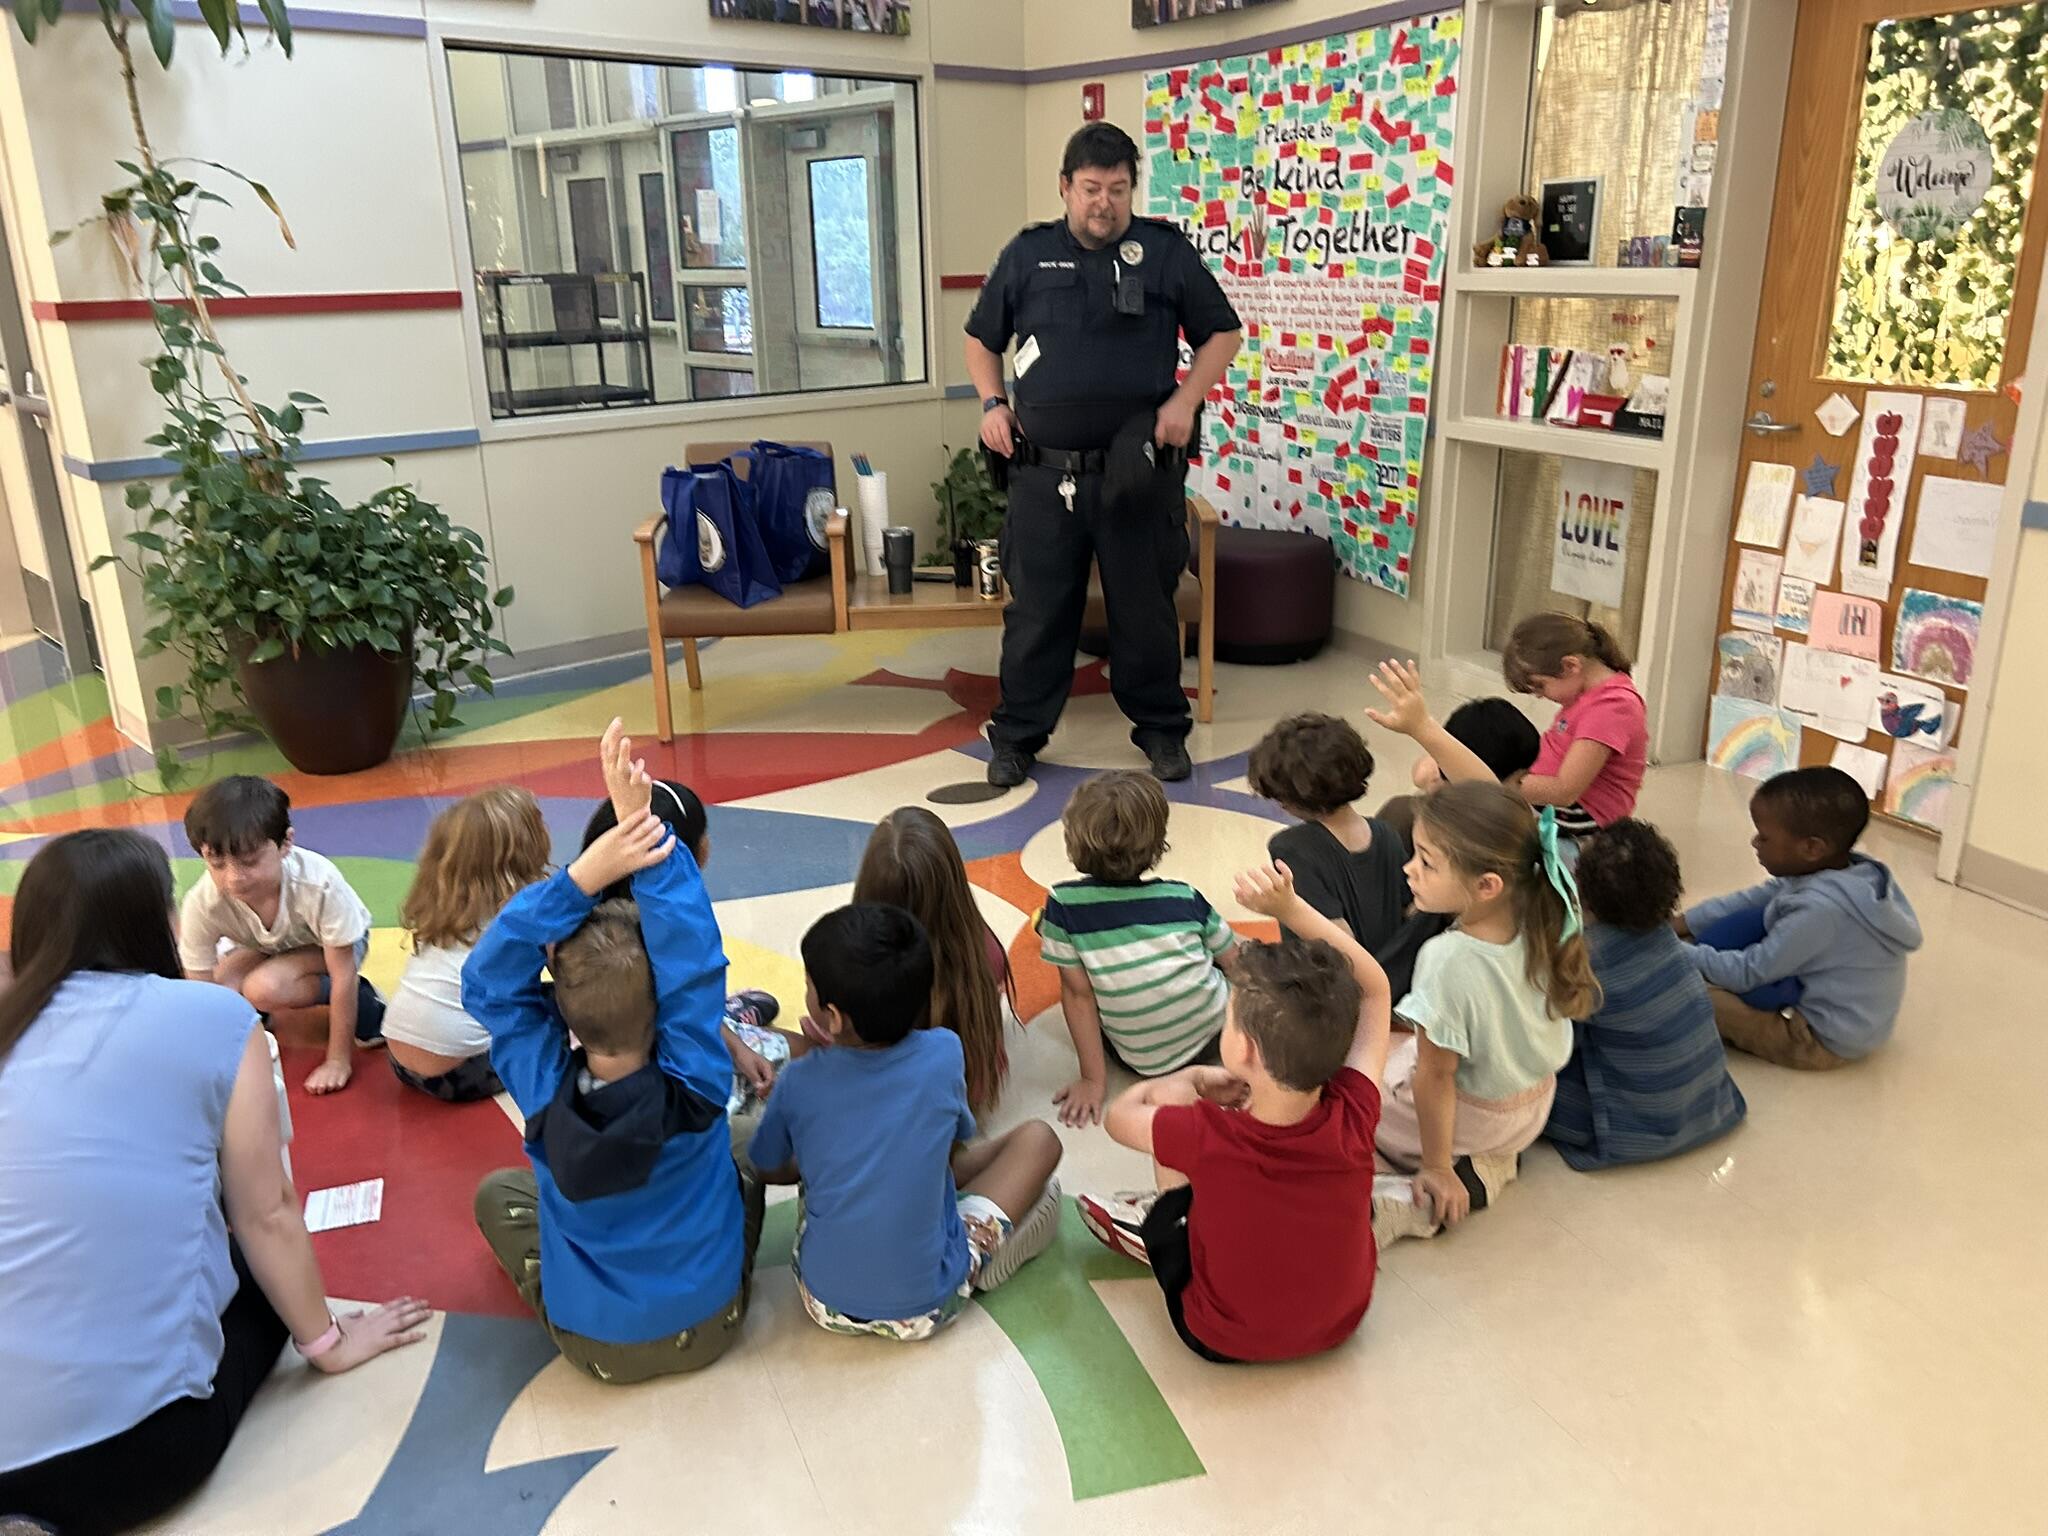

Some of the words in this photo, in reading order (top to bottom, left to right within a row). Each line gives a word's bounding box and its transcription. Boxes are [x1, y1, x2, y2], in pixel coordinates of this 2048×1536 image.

[1263, 118, 1316, 146] Pledge
[1320, 120, 1334, 139] to
[1241, 165, 1266, 199] Be
[1886, 154, 1976, 198] Welcome
[1182, 217, 1242, 255] tick
[1276, 209, 1416, 271] Together
[1562, 489, 1624, 551] LOVE
